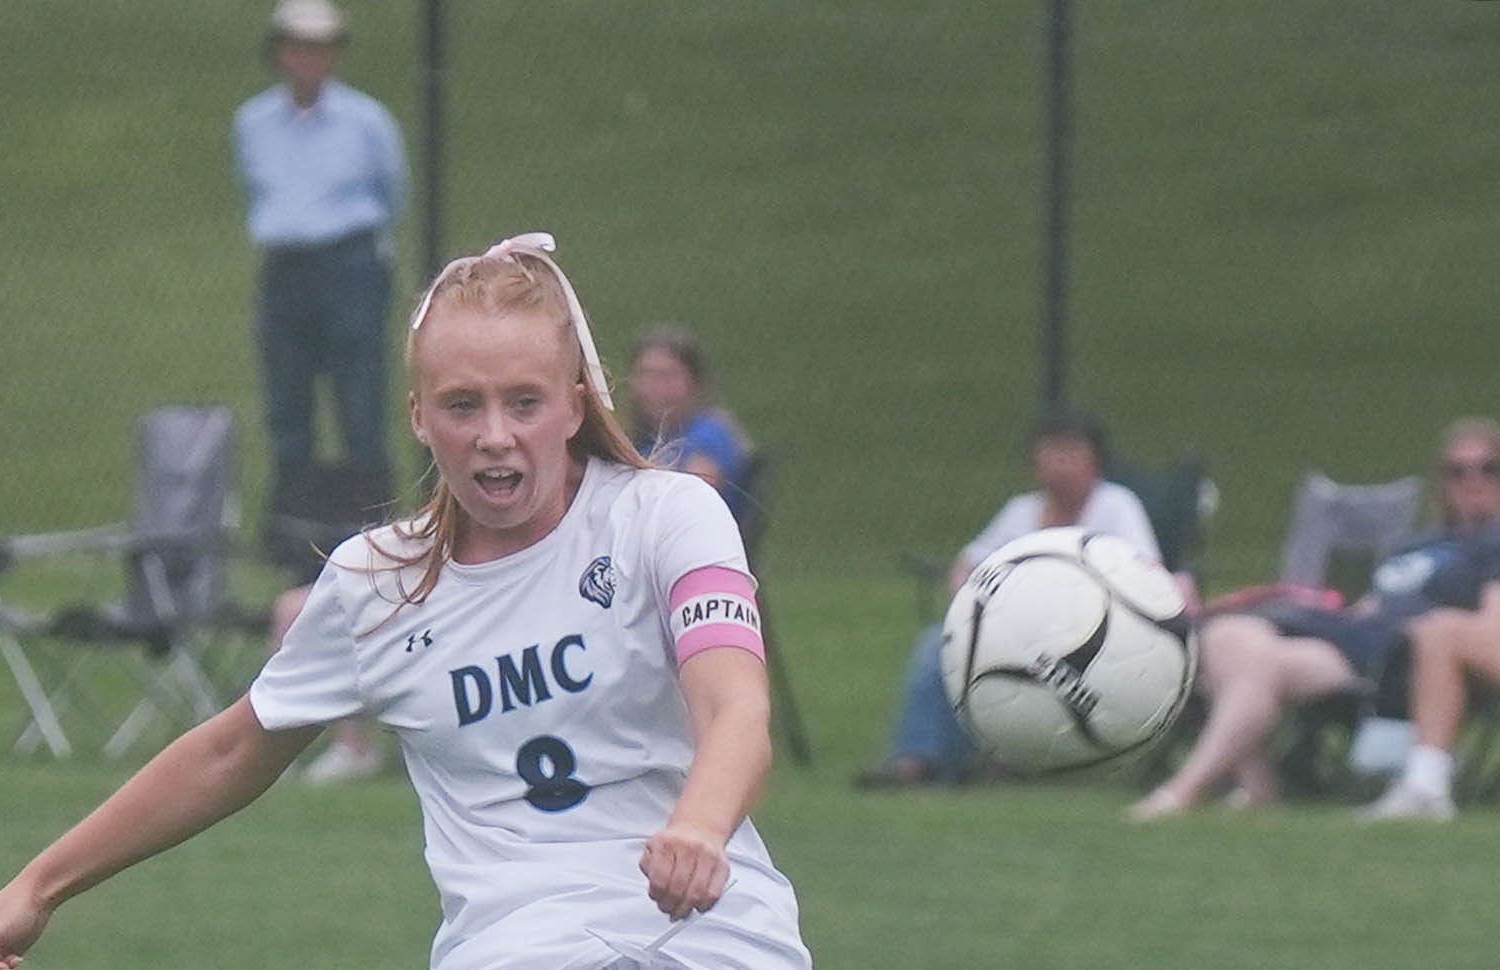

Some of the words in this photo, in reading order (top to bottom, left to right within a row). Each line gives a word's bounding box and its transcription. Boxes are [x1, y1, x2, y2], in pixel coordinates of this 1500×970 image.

[681, 599, 760, 631] CAPTAIN
[448, 633, 595, 728] DMC
[515, 733, 592, 814] 8
